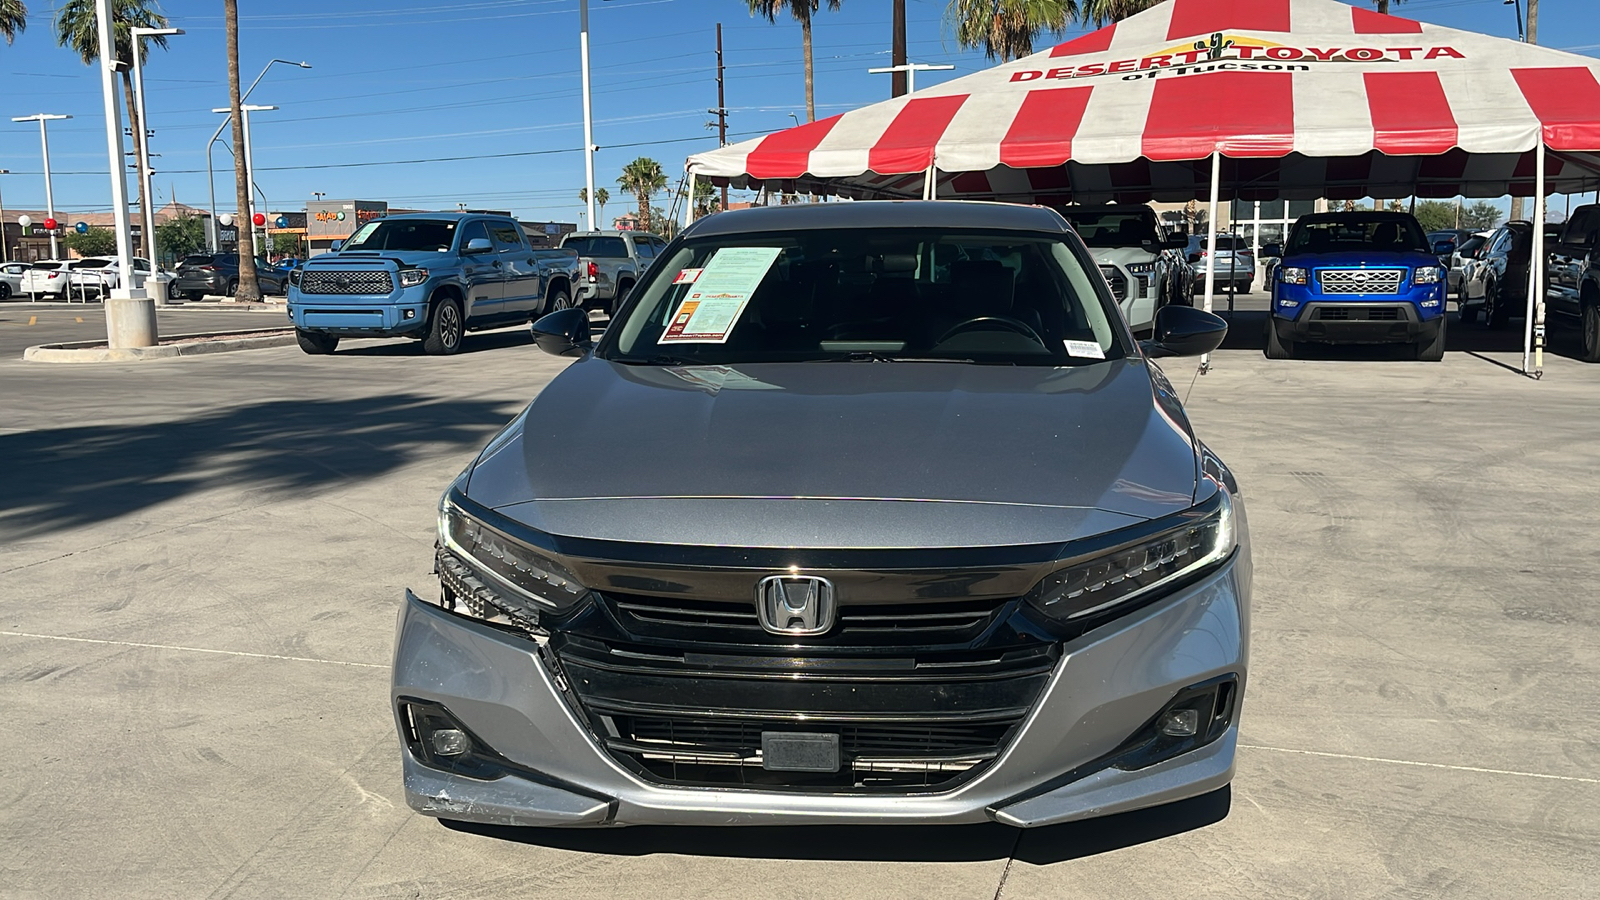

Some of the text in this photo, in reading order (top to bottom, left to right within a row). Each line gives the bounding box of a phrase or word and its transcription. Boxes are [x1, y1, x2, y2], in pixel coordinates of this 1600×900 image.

[1009, 45, 1466, 82] DESERT TOYOTA
[1122, 63, 1310, 81] of Tucson
